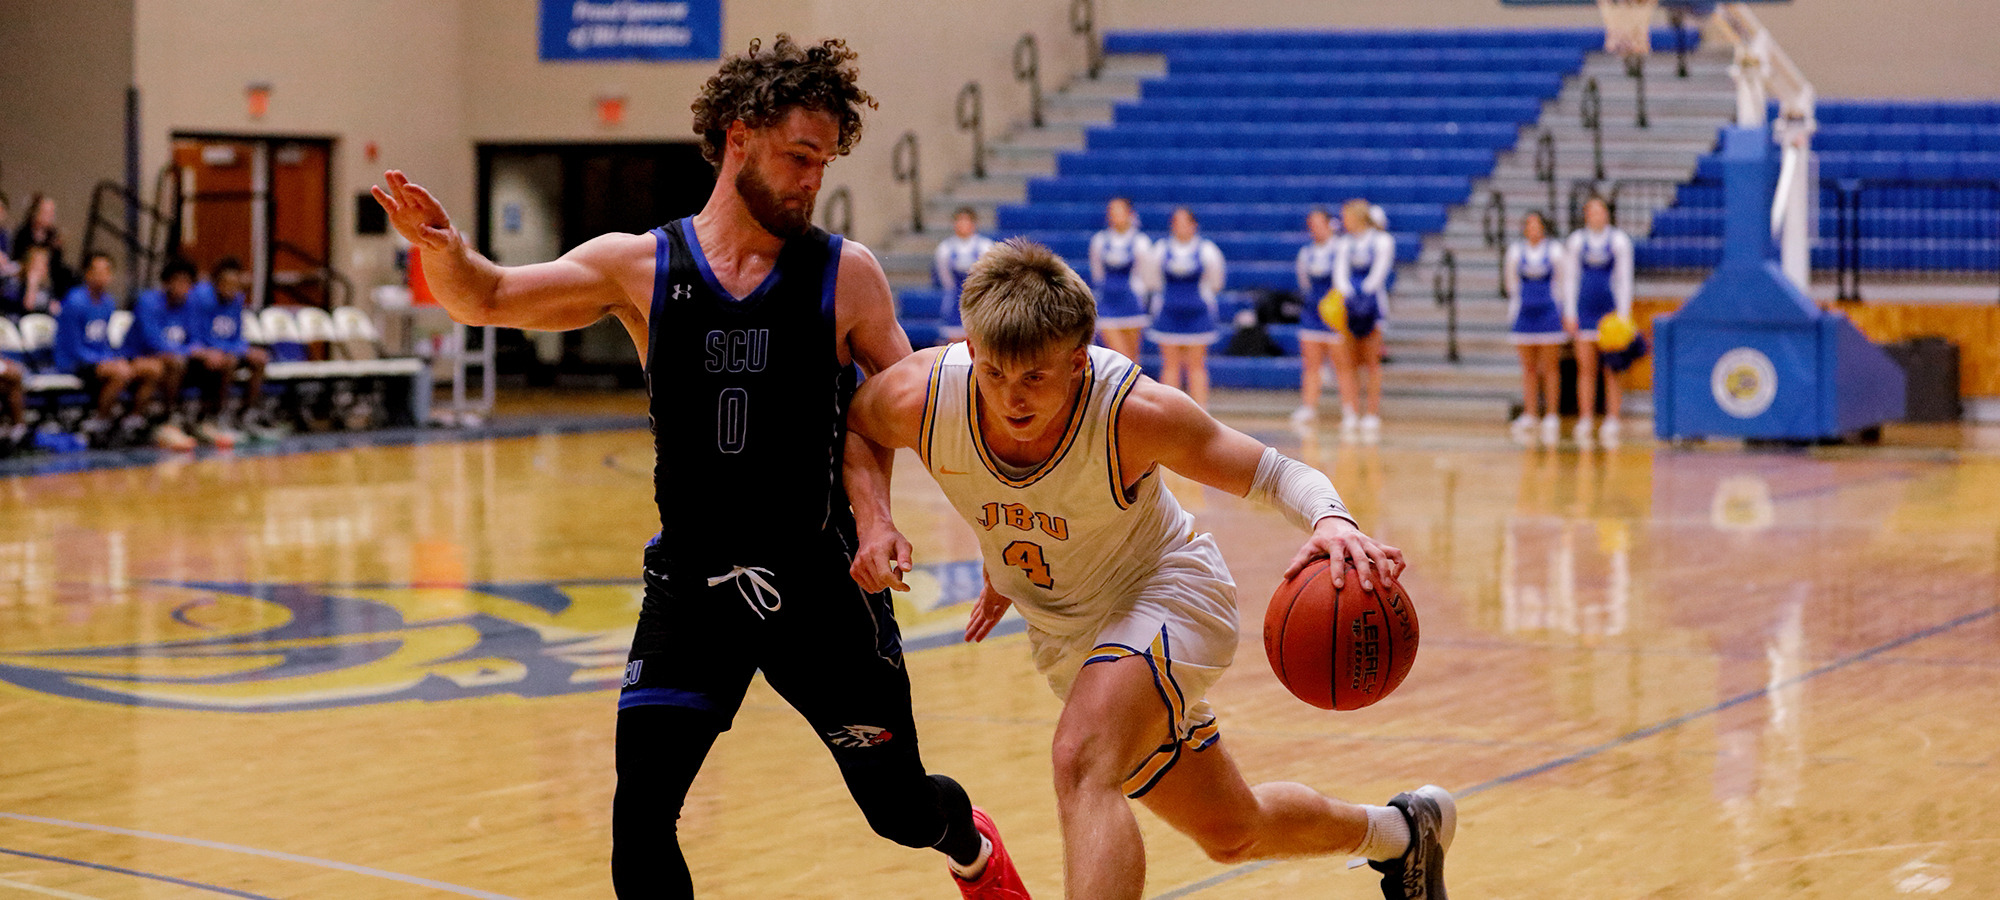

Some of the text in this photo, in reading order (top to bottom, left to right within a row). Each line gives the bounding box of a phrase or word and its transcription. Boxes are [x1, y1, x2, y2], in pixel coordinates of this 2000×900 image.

[705, 329, 769, 373] SCU
[717, 387, 748, 454] 0
[976, 502, 1069, 541] JBU
[1002, 540, 1054, 590] 4
[1362, 609, 1379, 695] LEGACY
